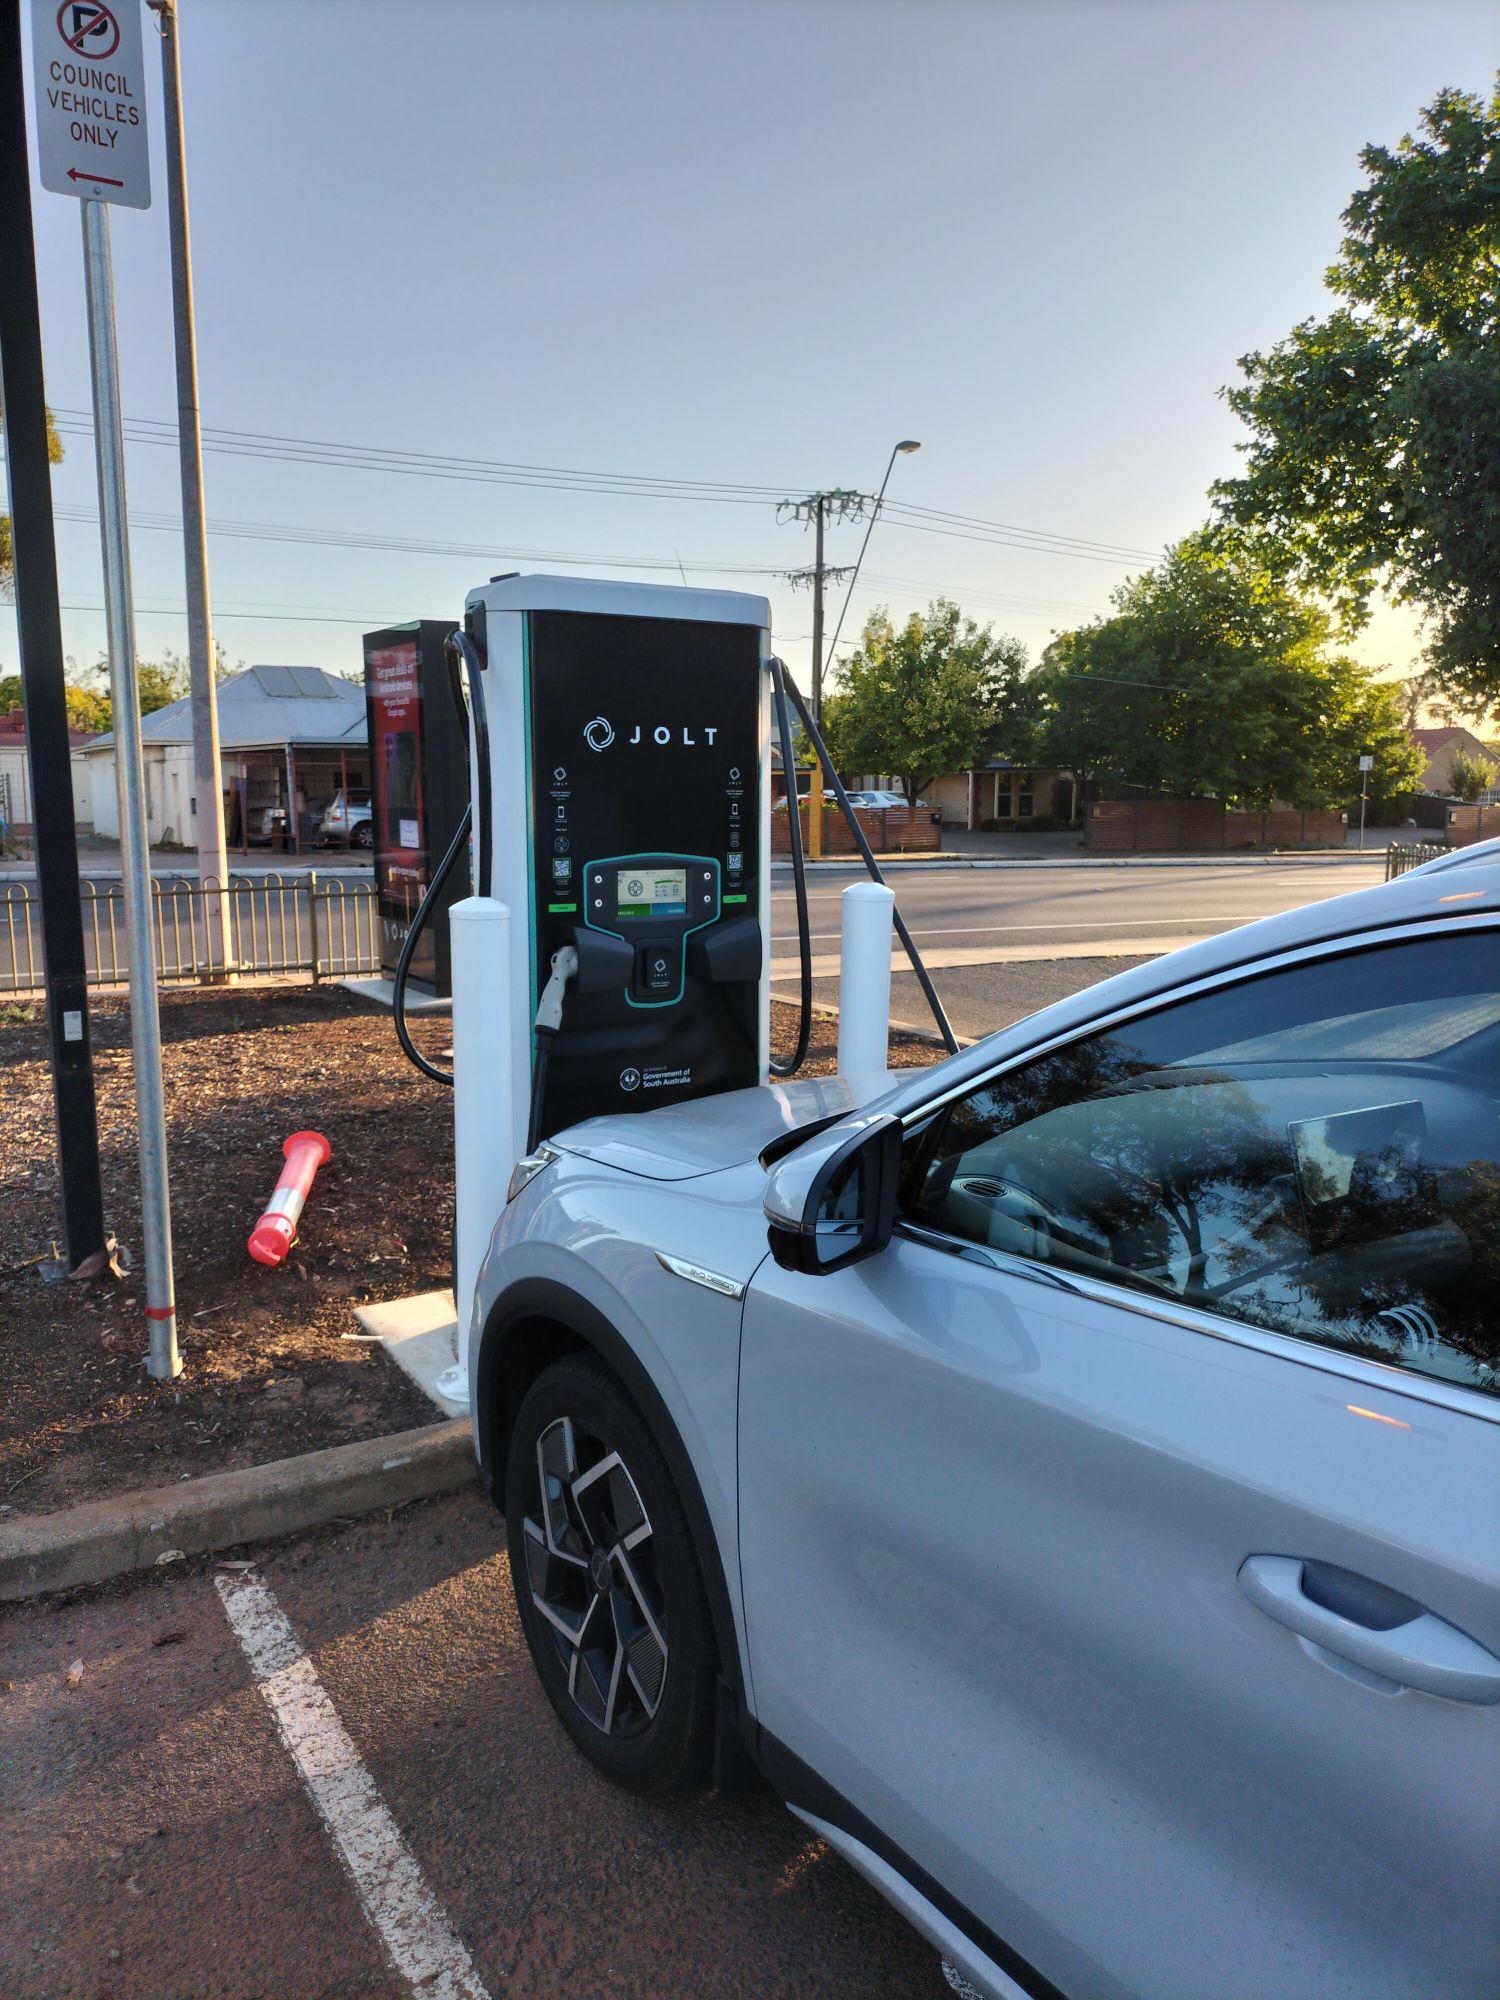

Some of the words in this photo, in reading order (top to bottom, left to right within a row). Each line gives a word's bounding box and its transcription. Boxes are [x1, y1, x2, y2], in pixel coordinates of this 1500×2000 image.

[50, 61, 133, 97] COUNCIL
[47, 88, 139, 126] VEHICLES
[70, 121, 119, 149] ONLY
[629, 726, 717, 745] JOLT
[643, 1070, 682, 1081] Government
[683, 1068, 691, 1077] of
[643, 1080, 662, 1088] South
[663, 1077, 691, 1086] Australia
